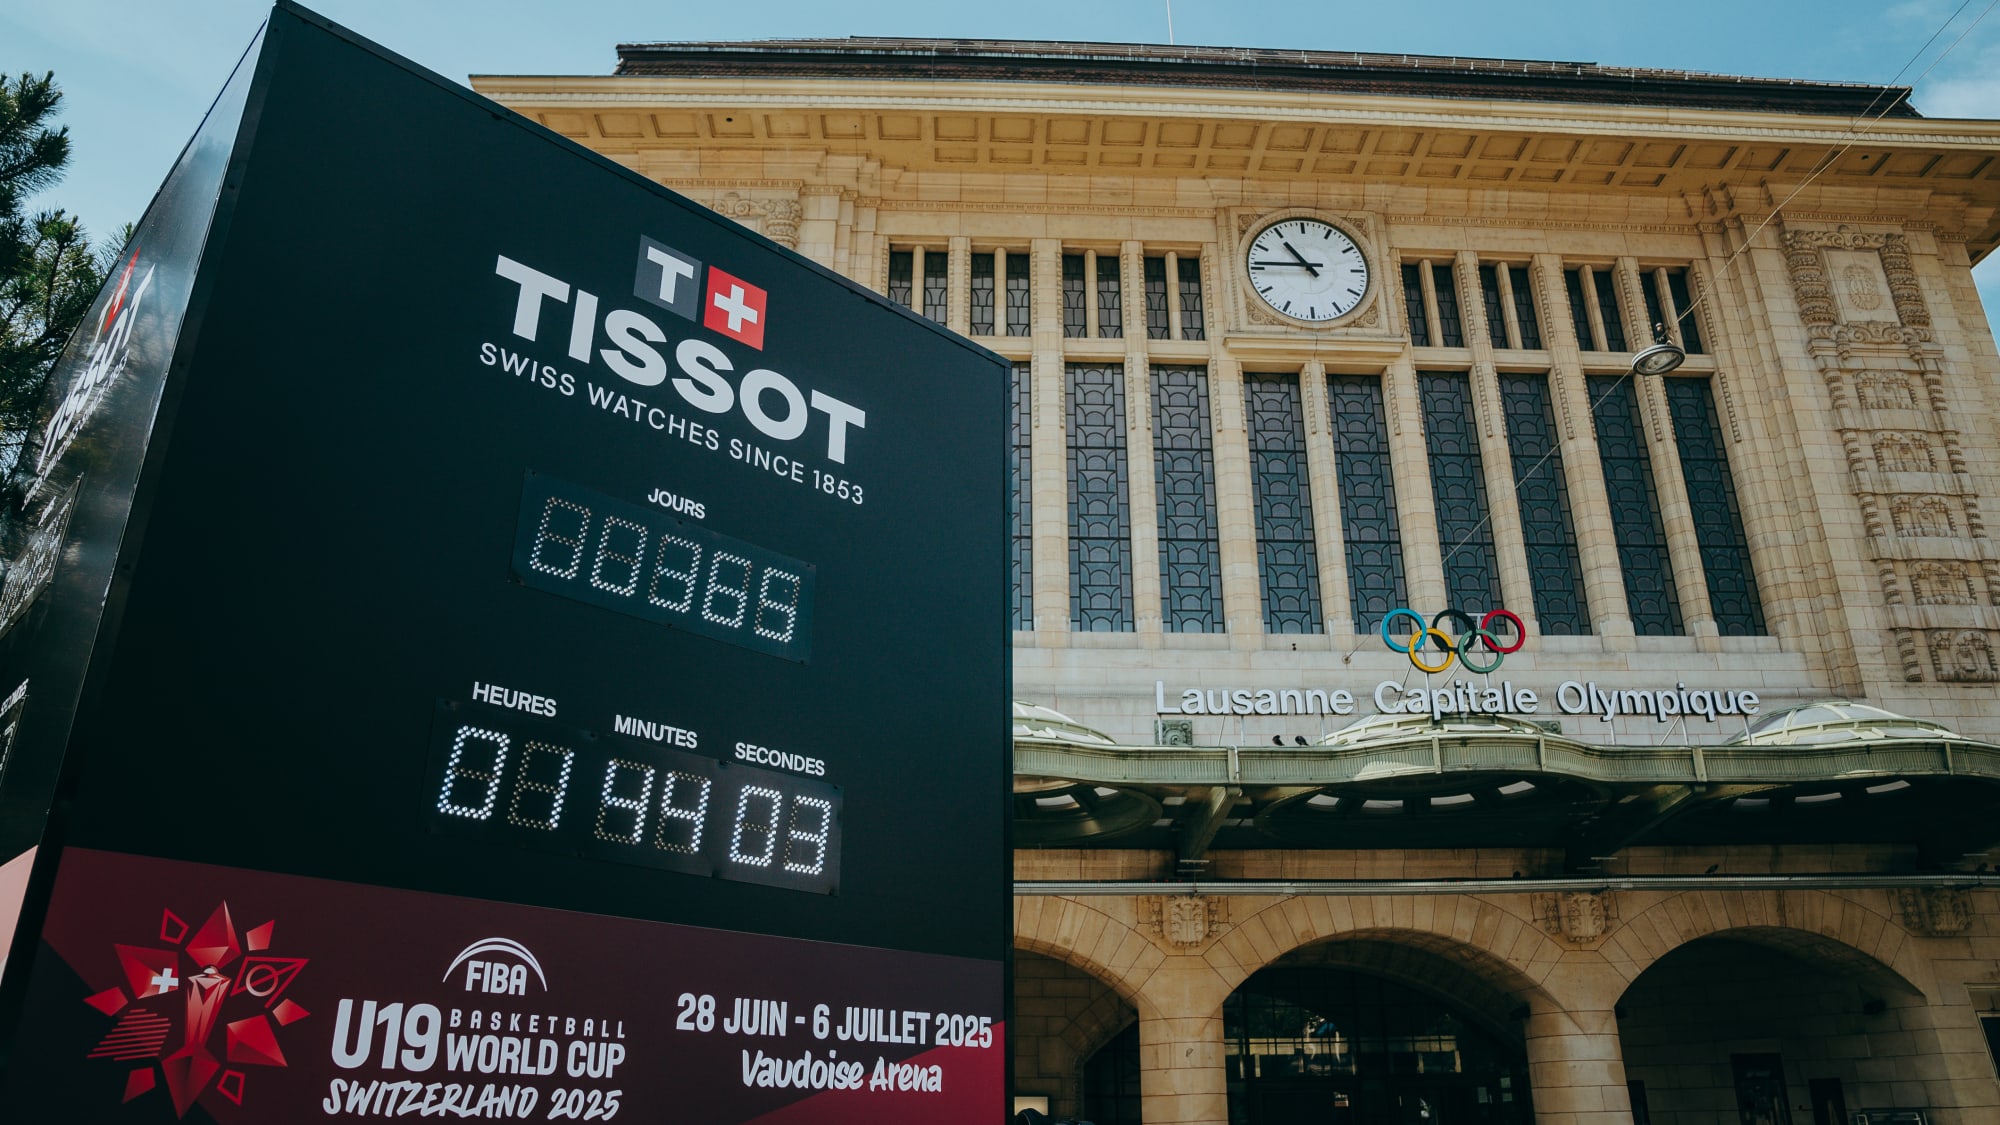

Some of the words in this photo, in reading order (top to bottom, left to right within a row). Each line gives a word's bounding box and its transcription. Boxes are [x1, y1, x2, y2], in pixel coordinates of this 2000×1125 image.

[647, 246, 694, 304] T
[496, 254, 866, 465] TISSOT
[479, 342, 576, 397] SWISS
[587, 381, 720, 451] WATCHES
[729, 438, 805, 484] SINCE
[813, 469, 864, 505] 1853
[648, 488, 706, 519] JOURS
[472, 681, 557, 718] HEURES
[1155, 680, 1354, 715] Lausanne
[1374, 680, 1539, 721] Capitale
[1556, 680, 1761, 723] Olympique
[614, 714, 698, 749] MINUTES
[735, 742, 825, 777] SECONDES
[729, 784, 832, 876] 03
[464, 959, 527, 996] FIBA
[330, 998, 442, 1072] U19
[449, 1007, 626, 1039] BASKETBALL
[676, 992, 716, 1033] 28
[723, 997, 787, 1036] JUIN
[794, 1015, 806, 1025] -
[812, 1003, 830, 1040] 6
[836, 1006, 931, 1045] JUILLET
[935, 1013, 993, 1049] 2025
[446, 1033, 558, 1076] WORLD
[566, 1039, 626, 1079] CUP
[742, 1049, 864, 1091] Vaudoise
[869, 1056, 942, 1093] Arena
[322, 1077, 539, 1120] SWITZERLAND
[549, 1088, 624, 1121] 2025
